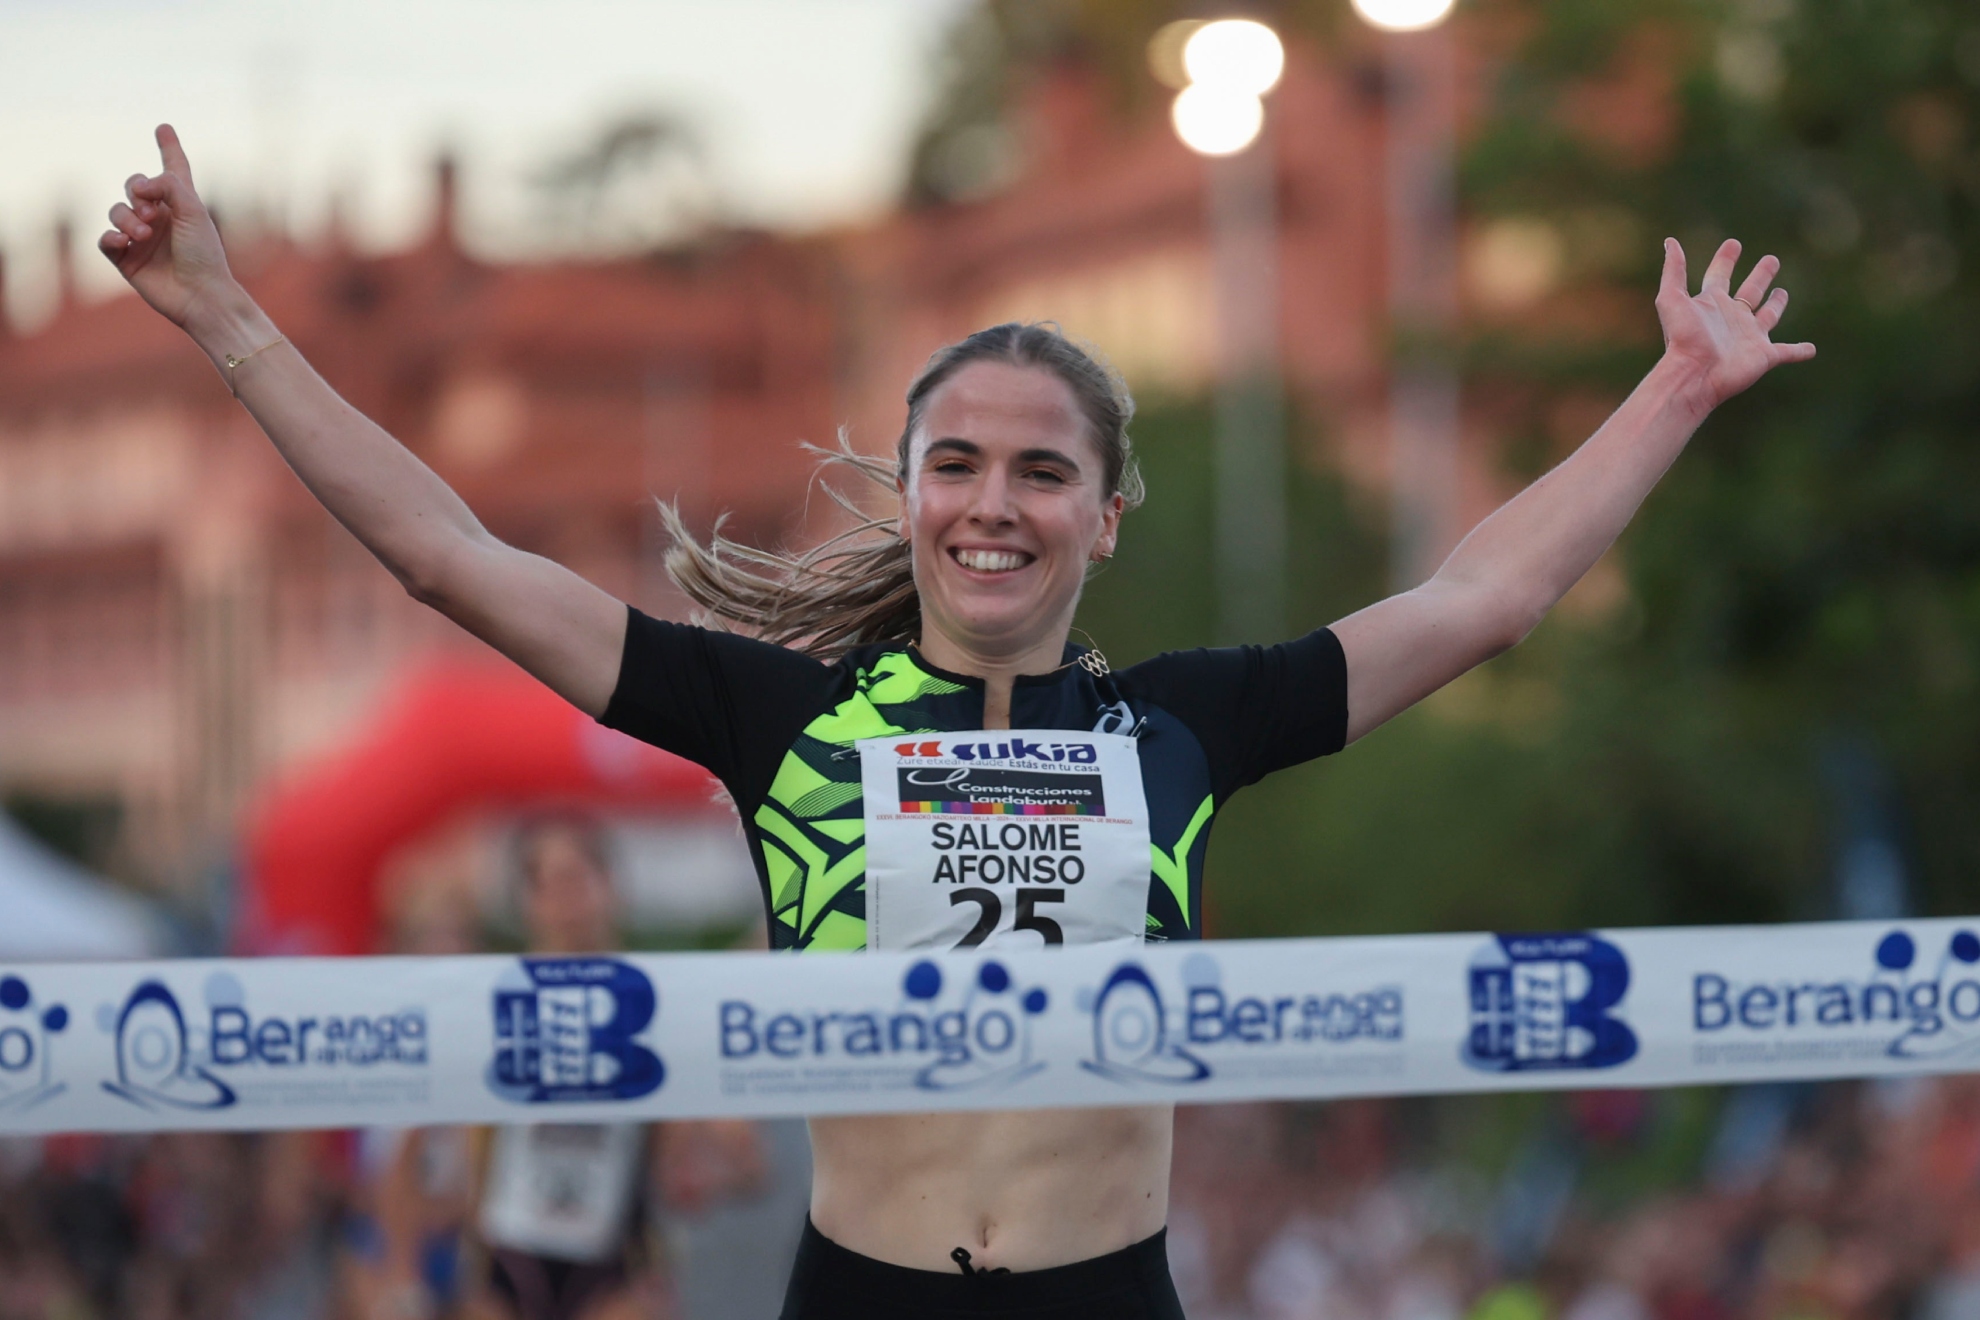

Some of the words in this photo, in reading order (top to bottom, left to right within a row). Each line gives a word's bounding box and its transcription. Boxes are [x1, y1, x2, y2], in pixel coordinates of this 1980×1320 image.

[896, 757, 923, 765] Zure
[1009, 759, 1039, 770] Estás
[1041, 763, 1056, 771] en
[1058, 763, 1071, 772] tu
[1074, 765, 1100, 773] casa
[957, 783, 1092, 796] Construcciones
[969, 795, 1067, 806] Landaburu
[931, 822, 1081, 851] SALOME
[932, 854, 1085, 885] AFONSO
[949, 886, 1065, 952] 25
[1694, 973, 1980, 1035] Berango
[720, 999, 1015, 1066] Berango
